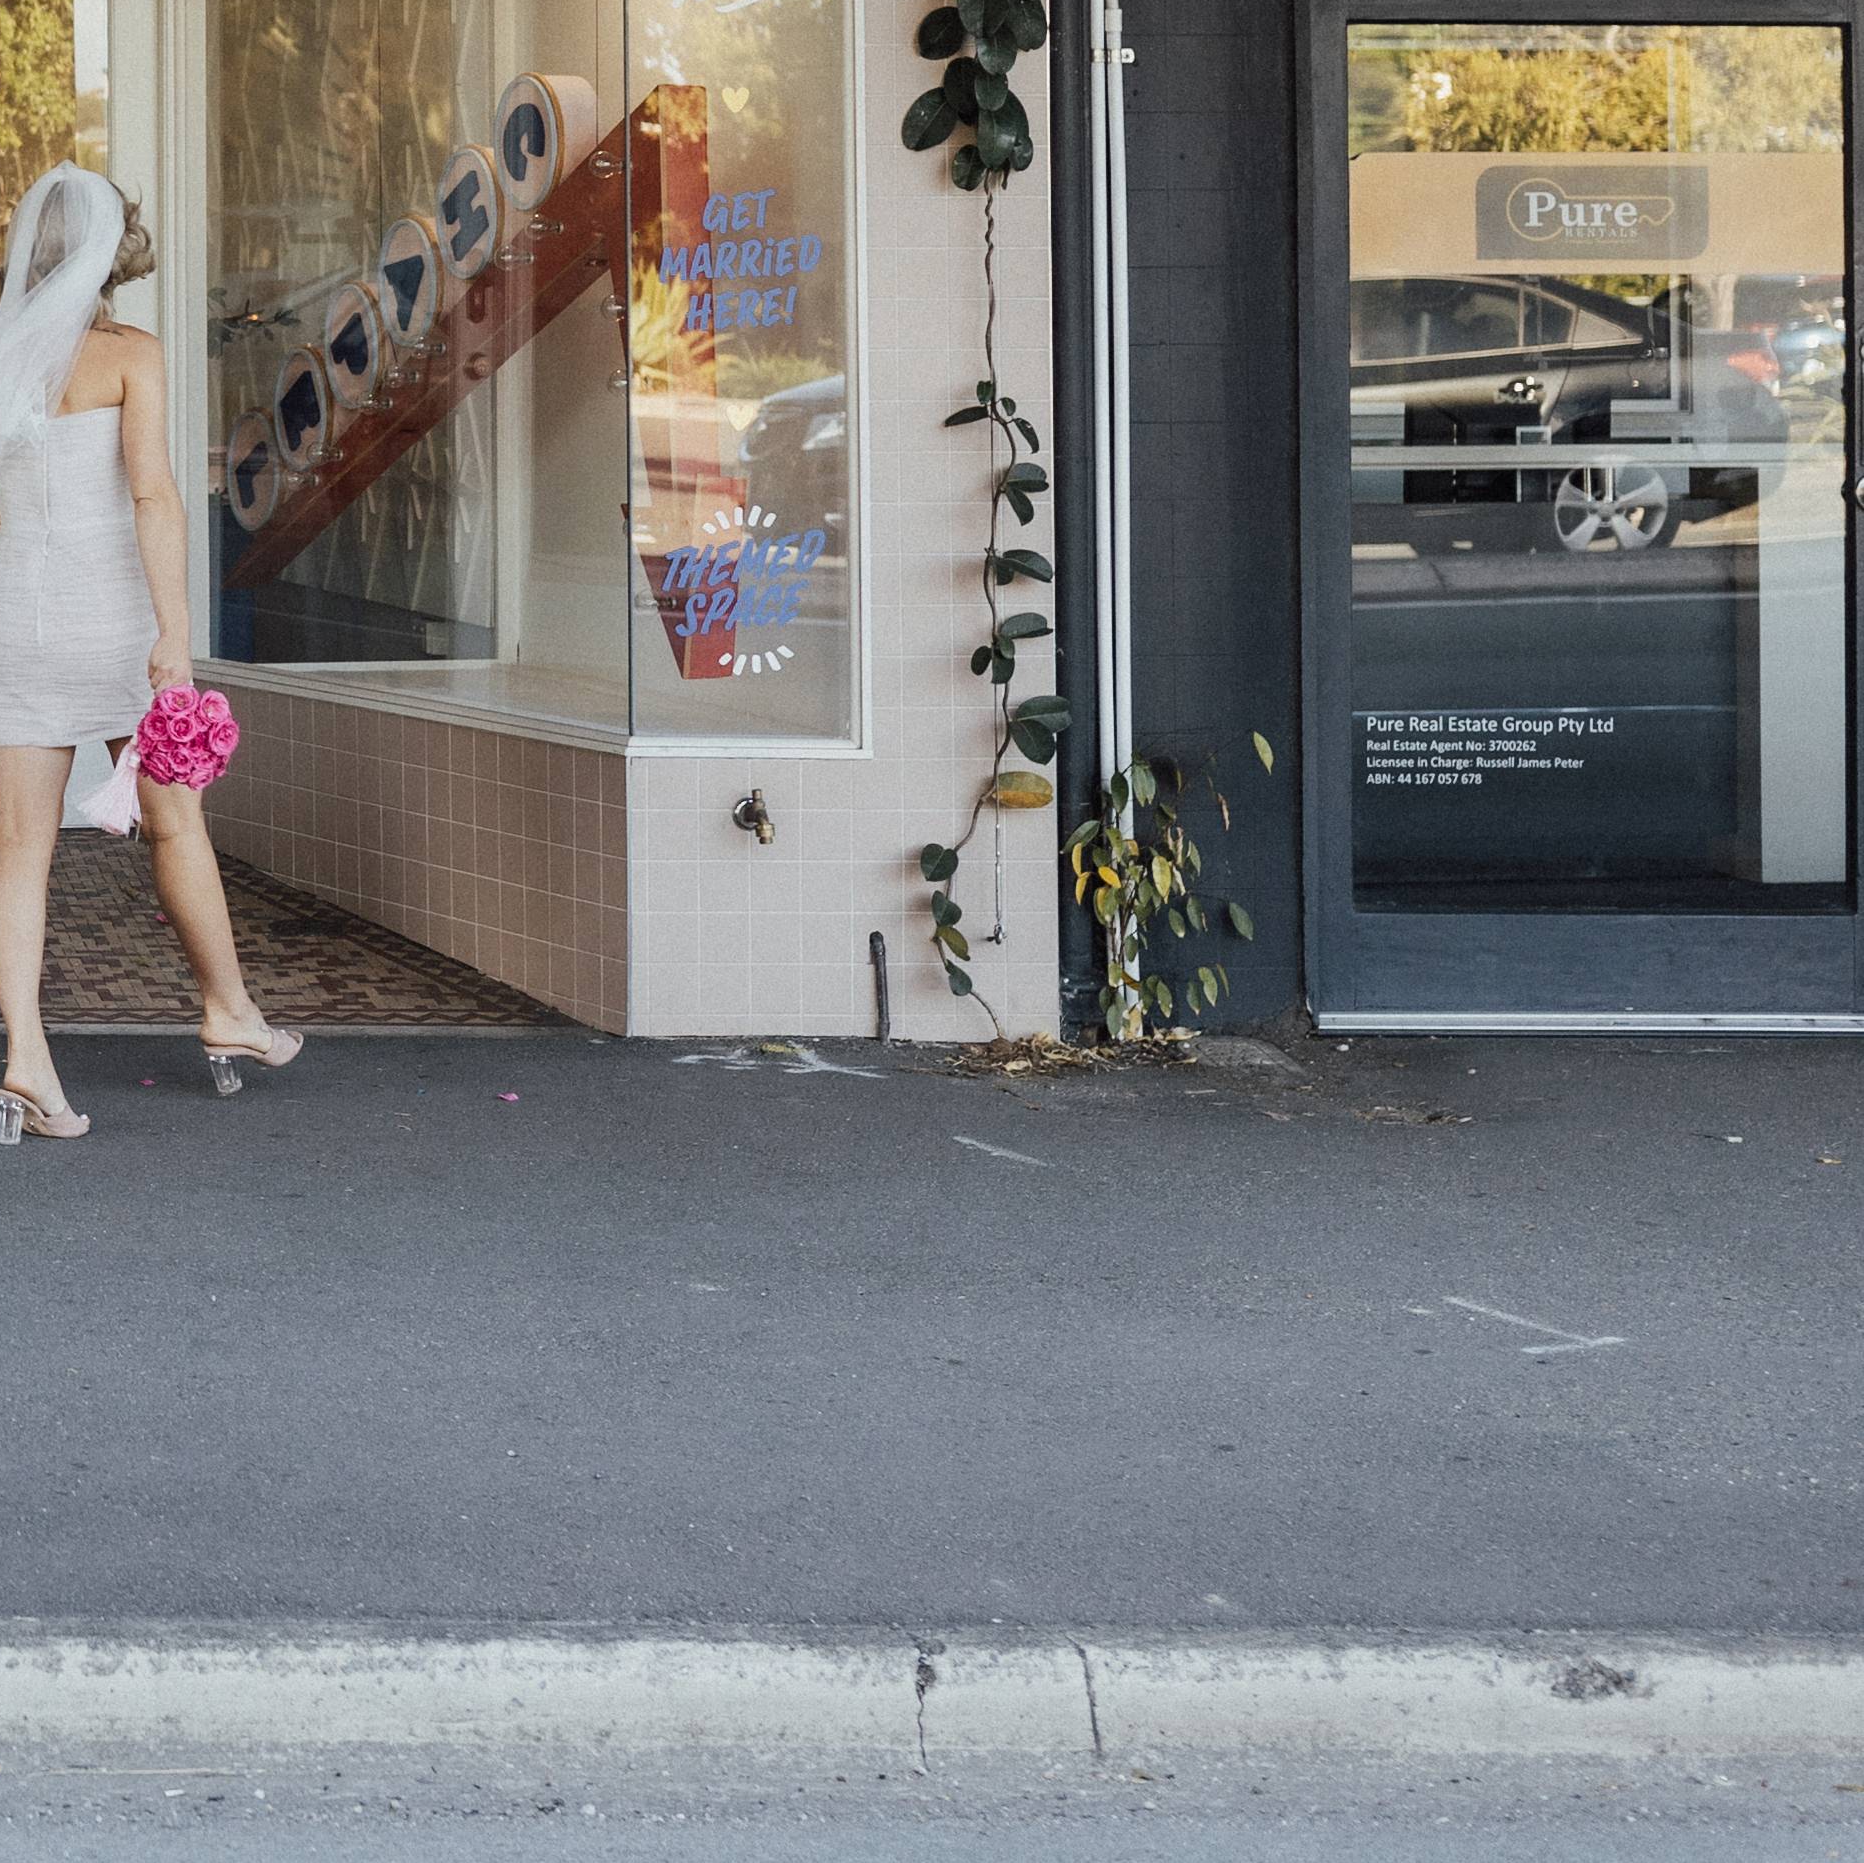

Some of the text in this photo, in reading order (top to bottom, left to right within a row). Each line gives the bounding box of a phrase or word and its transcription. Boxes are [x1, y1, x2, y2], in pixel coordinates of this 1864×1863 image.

[701, 188, 778, 234] GET
[1523, 191, 1639, 228] Pure
[685, 285, 799, 332] HERE!
[661, 528, 827, 593] THEMED
[674, 578, 811, 638] SPACE
[1366, 716, 1614, 736] Pure Real Estate Group Pty Ltd
[1366, 739, 1536, 753] Real Estate Agent No: 3700262
[1366, 756, 1584, 770] Licensee in Charge: Russell James Peter
[1366, 773, 1482, 784] ABN: 44 167 057 678
